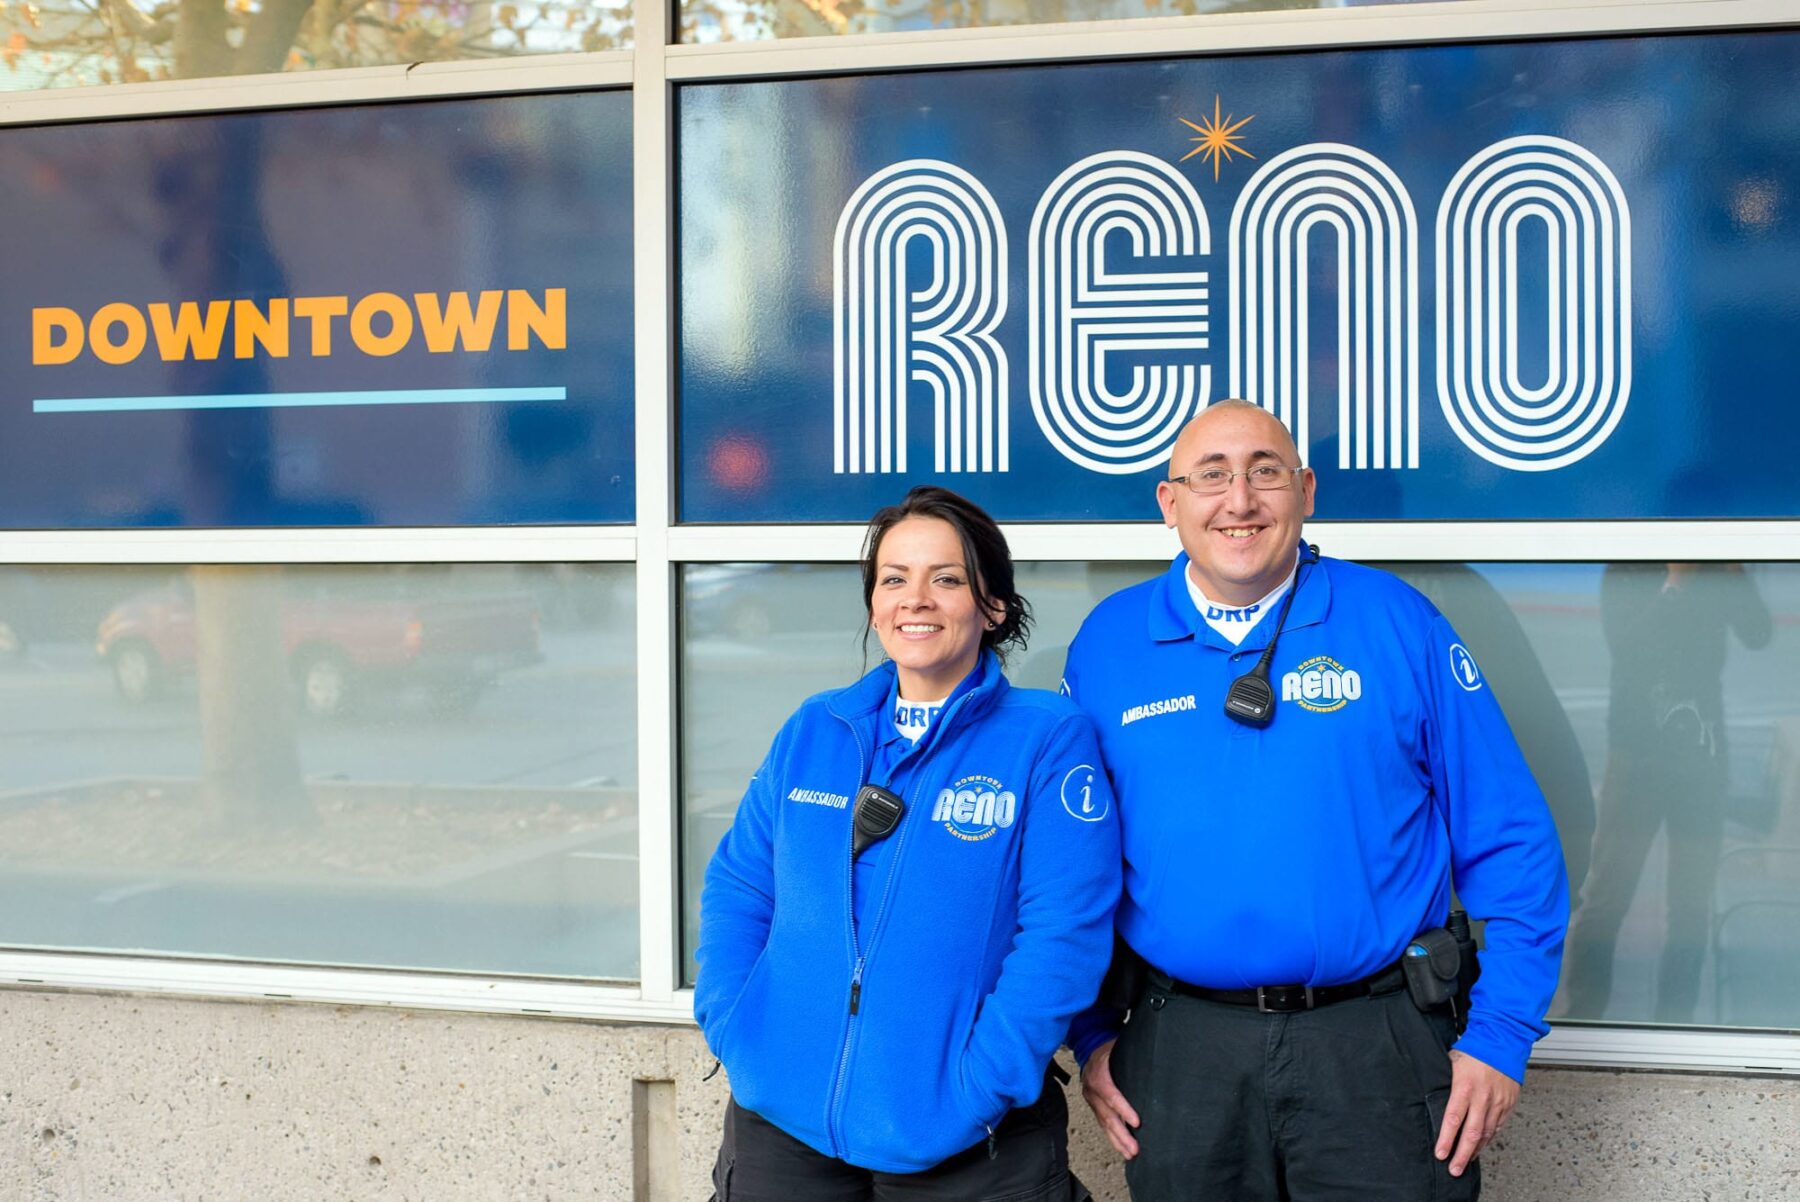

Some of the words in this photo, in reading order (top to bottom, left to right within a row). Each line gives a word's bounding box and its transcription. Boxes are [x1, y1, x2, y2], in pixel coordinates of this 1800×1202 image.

[833, 135, 1633, 474] RENO
[32, 288, 566, 365] DOWNTOWN
[1206, 604, 1260, 622] DRP
[1282, 669, 1362, 702] RENO
[1121, 695, 1196, 726] AMBASSADOR
[787, 787, 849, 809] AMBASSADOR
[955, 775, 1003, 789] DOWNTOWN
[931, 788, 1016, 828] RENO
